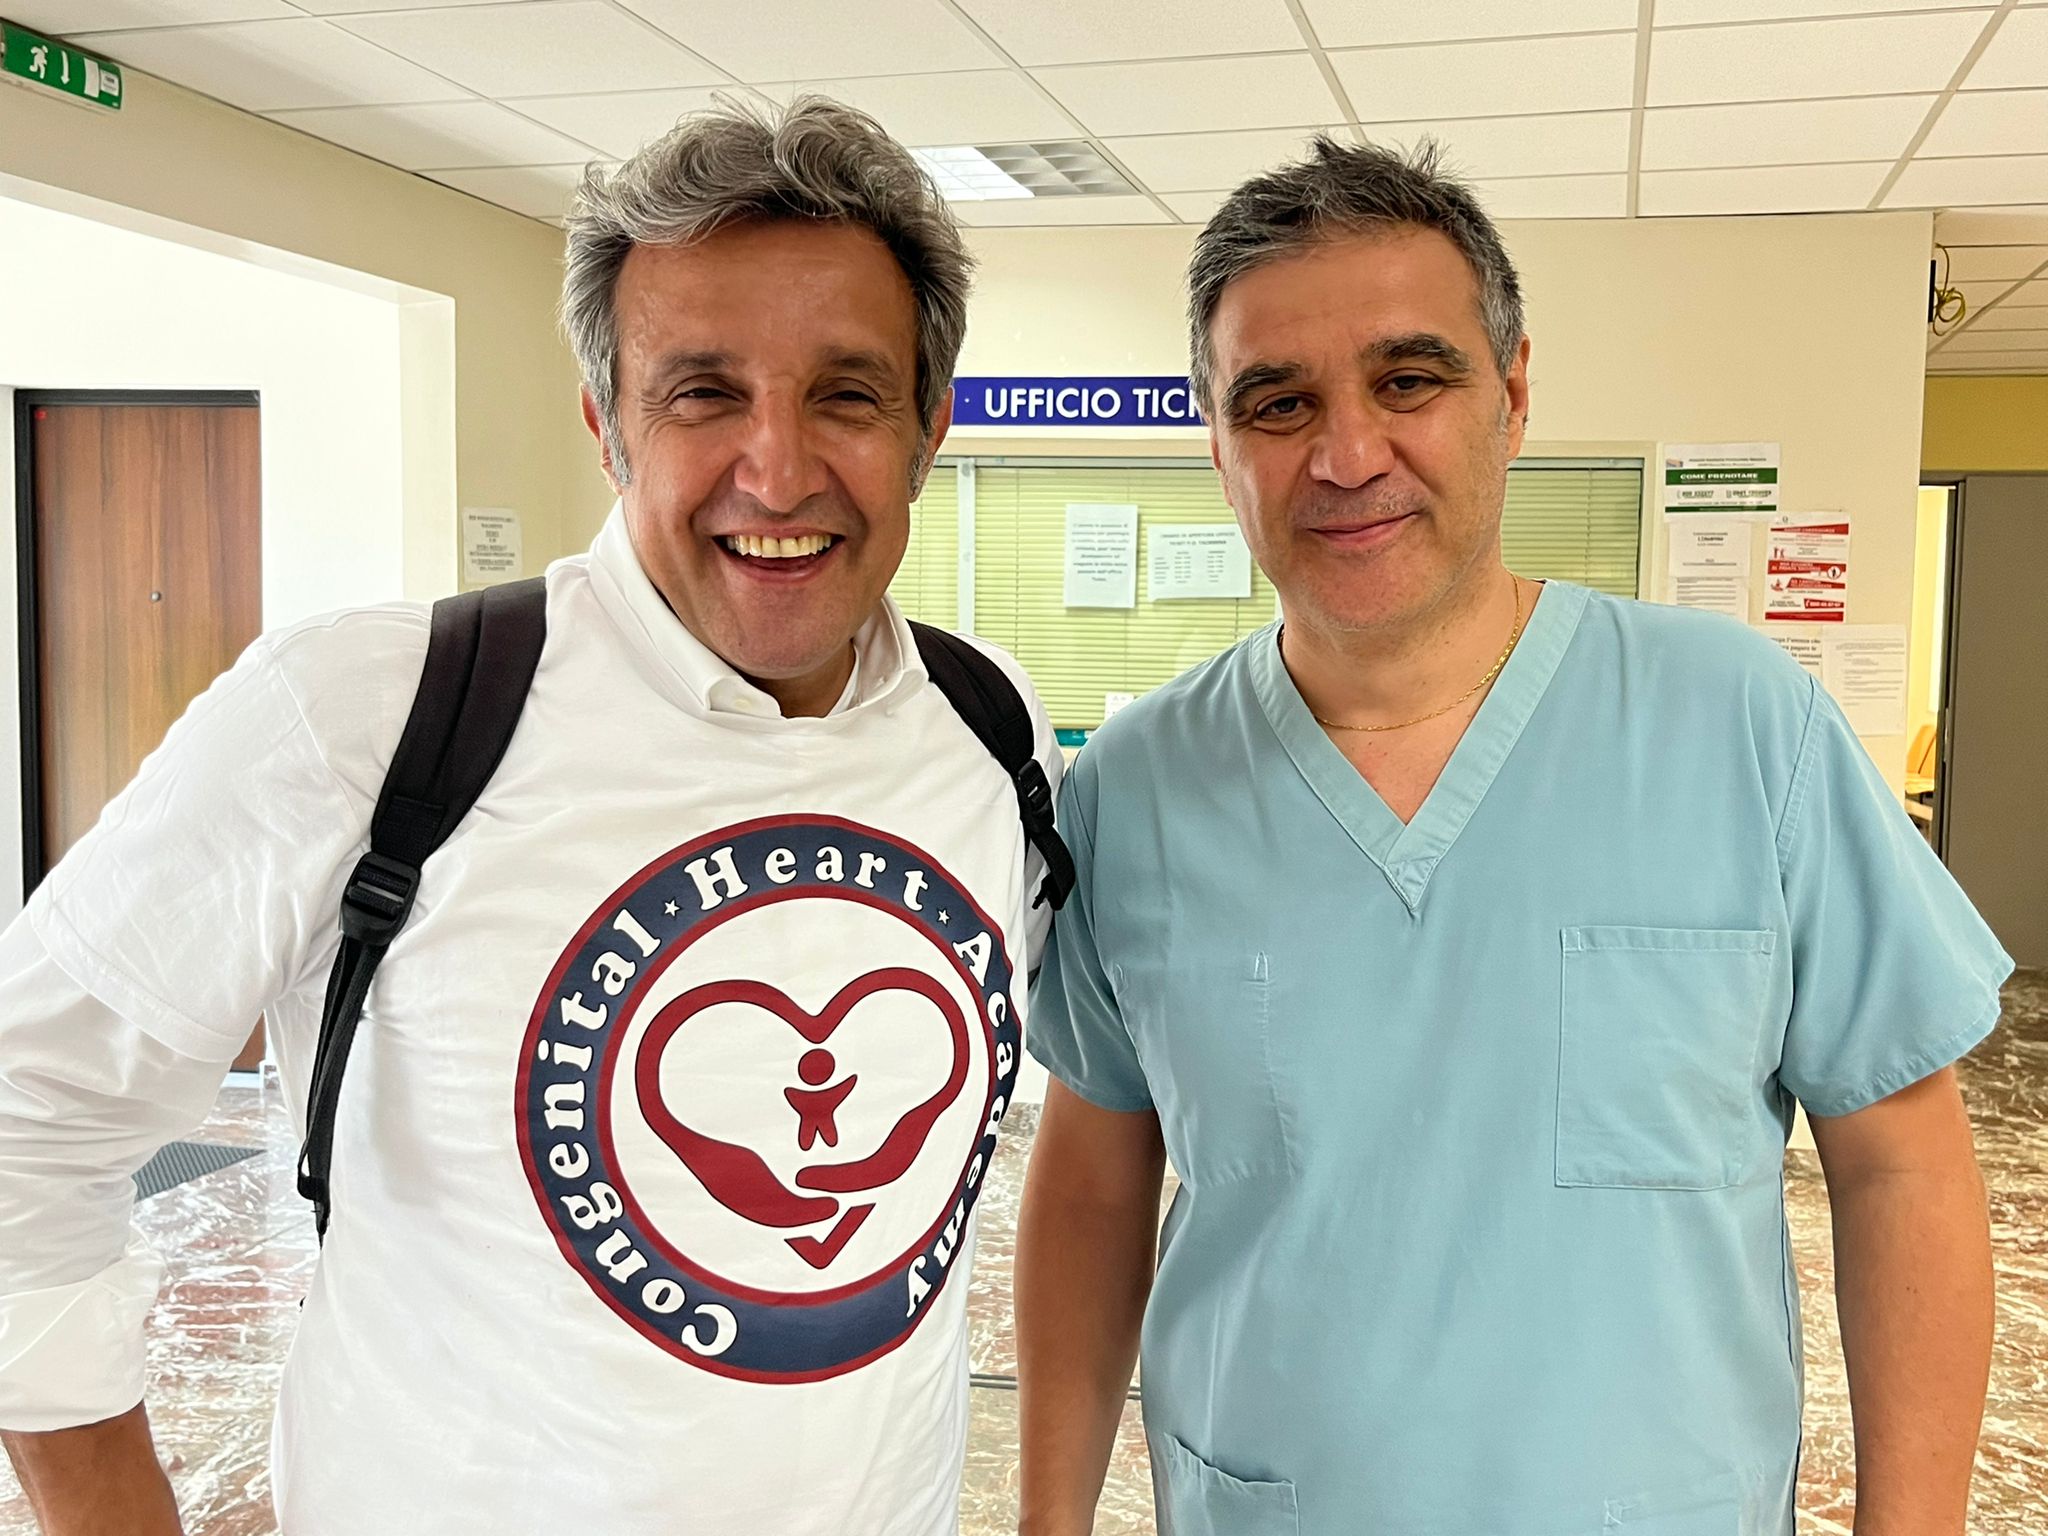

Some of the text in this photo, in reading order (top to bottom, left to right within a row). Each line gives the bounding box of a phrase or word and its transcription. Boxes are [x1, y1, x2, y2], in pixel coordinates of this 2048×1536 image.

[984, 387, 1122, 419] UFFICIO
[1680, 472, 1759, 480] COME PRENOTARE
[537, 845, 1014, 1357] Congenital Heart Academy
